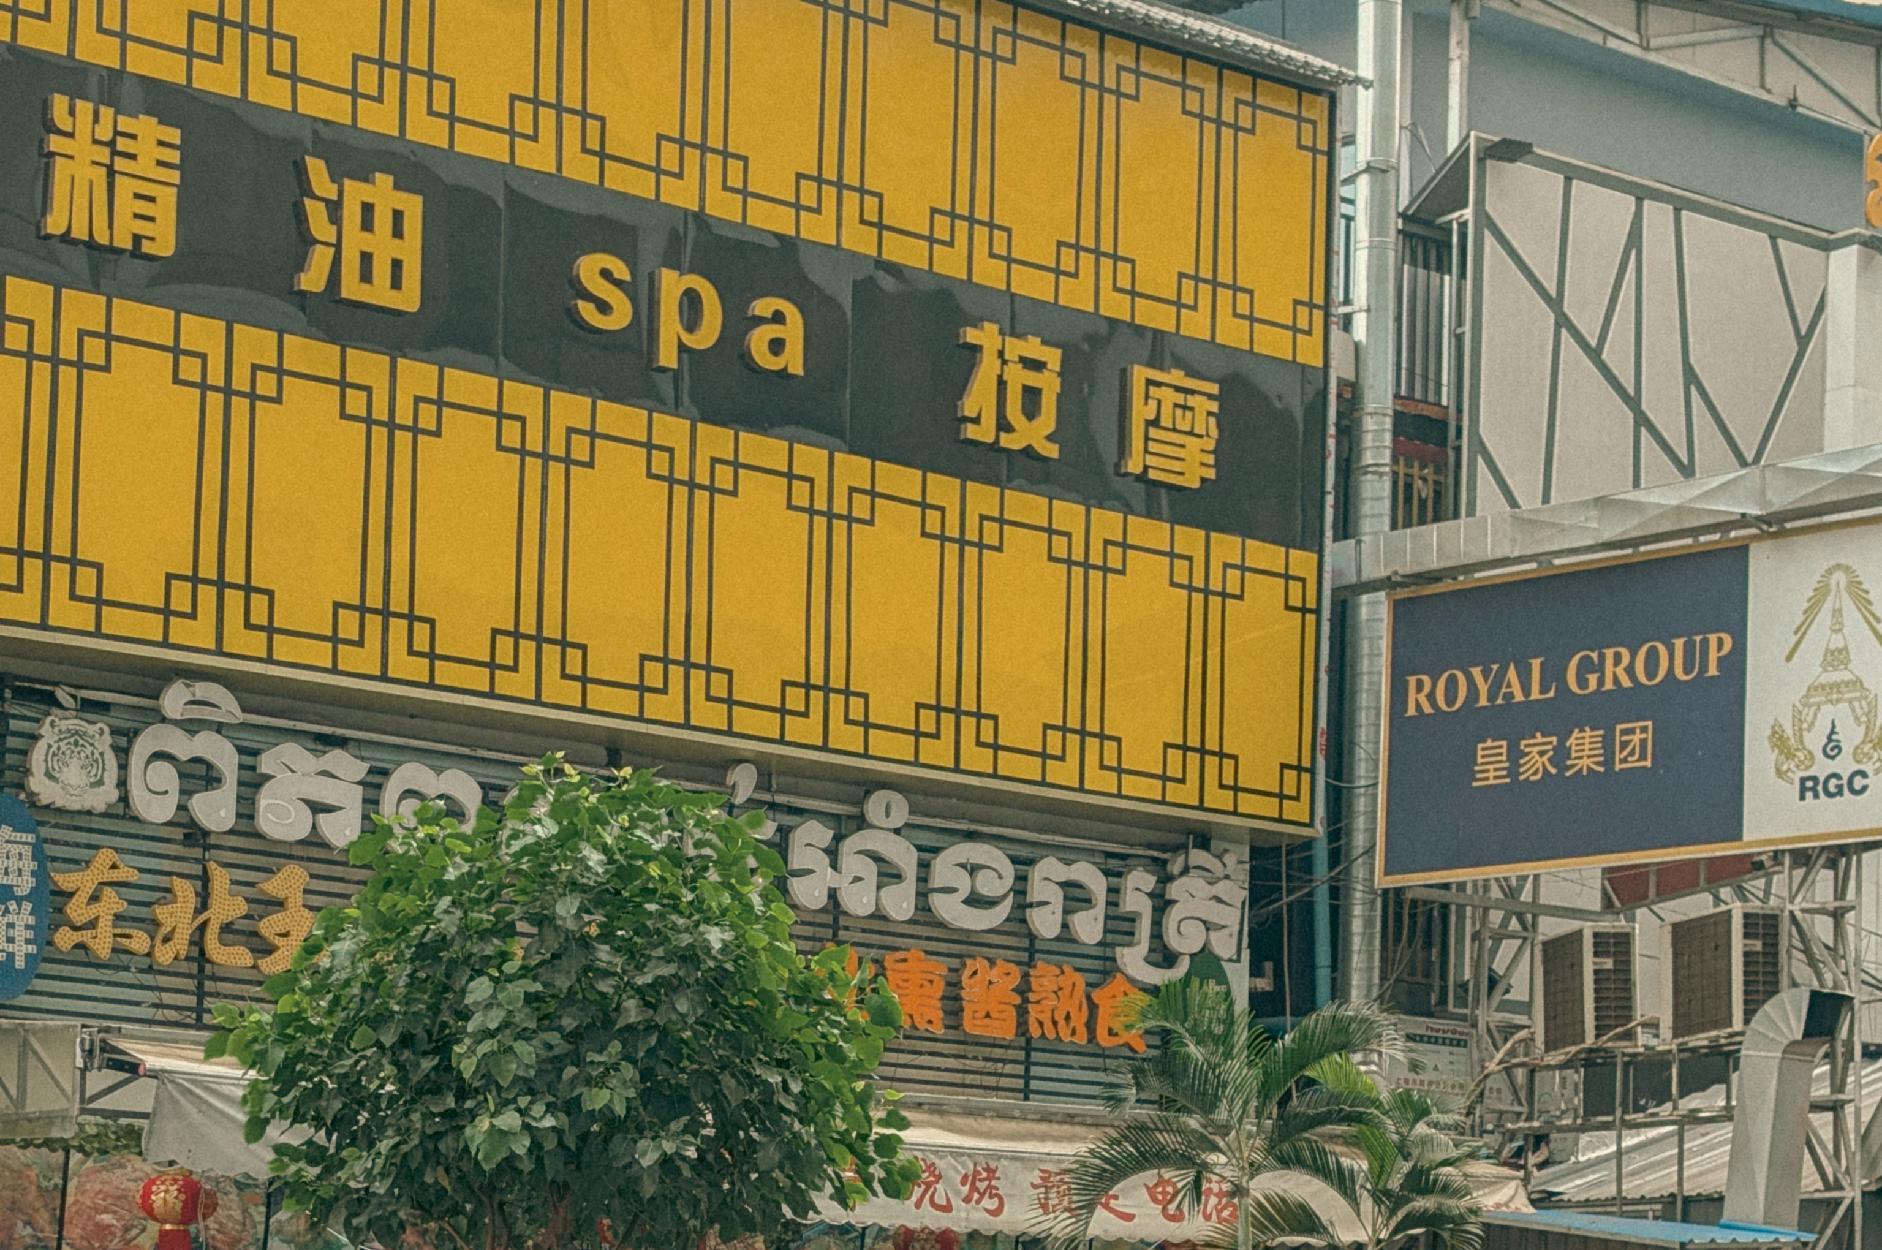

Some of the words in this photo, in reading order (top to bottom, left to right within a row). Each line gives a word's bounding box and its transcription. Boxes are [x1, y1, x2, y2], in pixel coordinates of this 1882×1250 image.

[41, 92, 425, 315] 精油
[570, 252, 806, 378] spa
[957, 320, 1220, 490] 按摩
[1404, 657, 1556, 718] ROYAL
[1566, 630, 1734, 694] GROUP
[1470, 720, 1654, 788] 皇家集团
[1798, 769, 1870, 802] RGC
